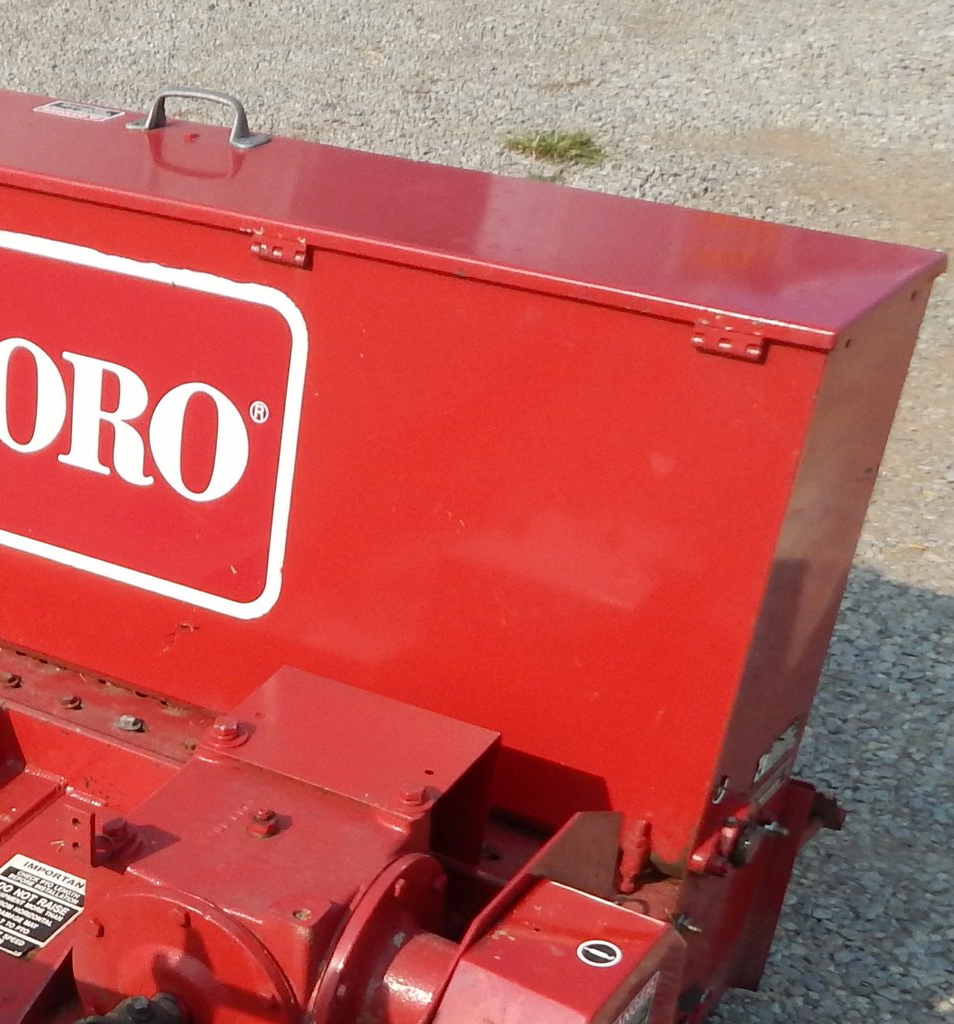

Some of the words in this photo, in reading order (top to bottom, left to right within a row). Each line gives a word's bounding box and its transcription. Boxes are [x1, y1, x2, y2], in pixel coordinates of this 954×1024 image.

[23, 861, 85, 889] IMPORTAN
[13, 888, 38, 902] NOT
[36, 898, 70, 916] RAISE
[34, 884, 80, 904] INSTALLATION
[12, 906, 52, 927] HORIZONTAL
[24, 902, 45, 914] MORE
[45, 910, 64, 922] THAN
[5, 920, 15, 928] TO
[14, 925, 30, 934] PTO
[23, 920, 39, 929] MAY
[2, 933, 25, 946] SPEED
